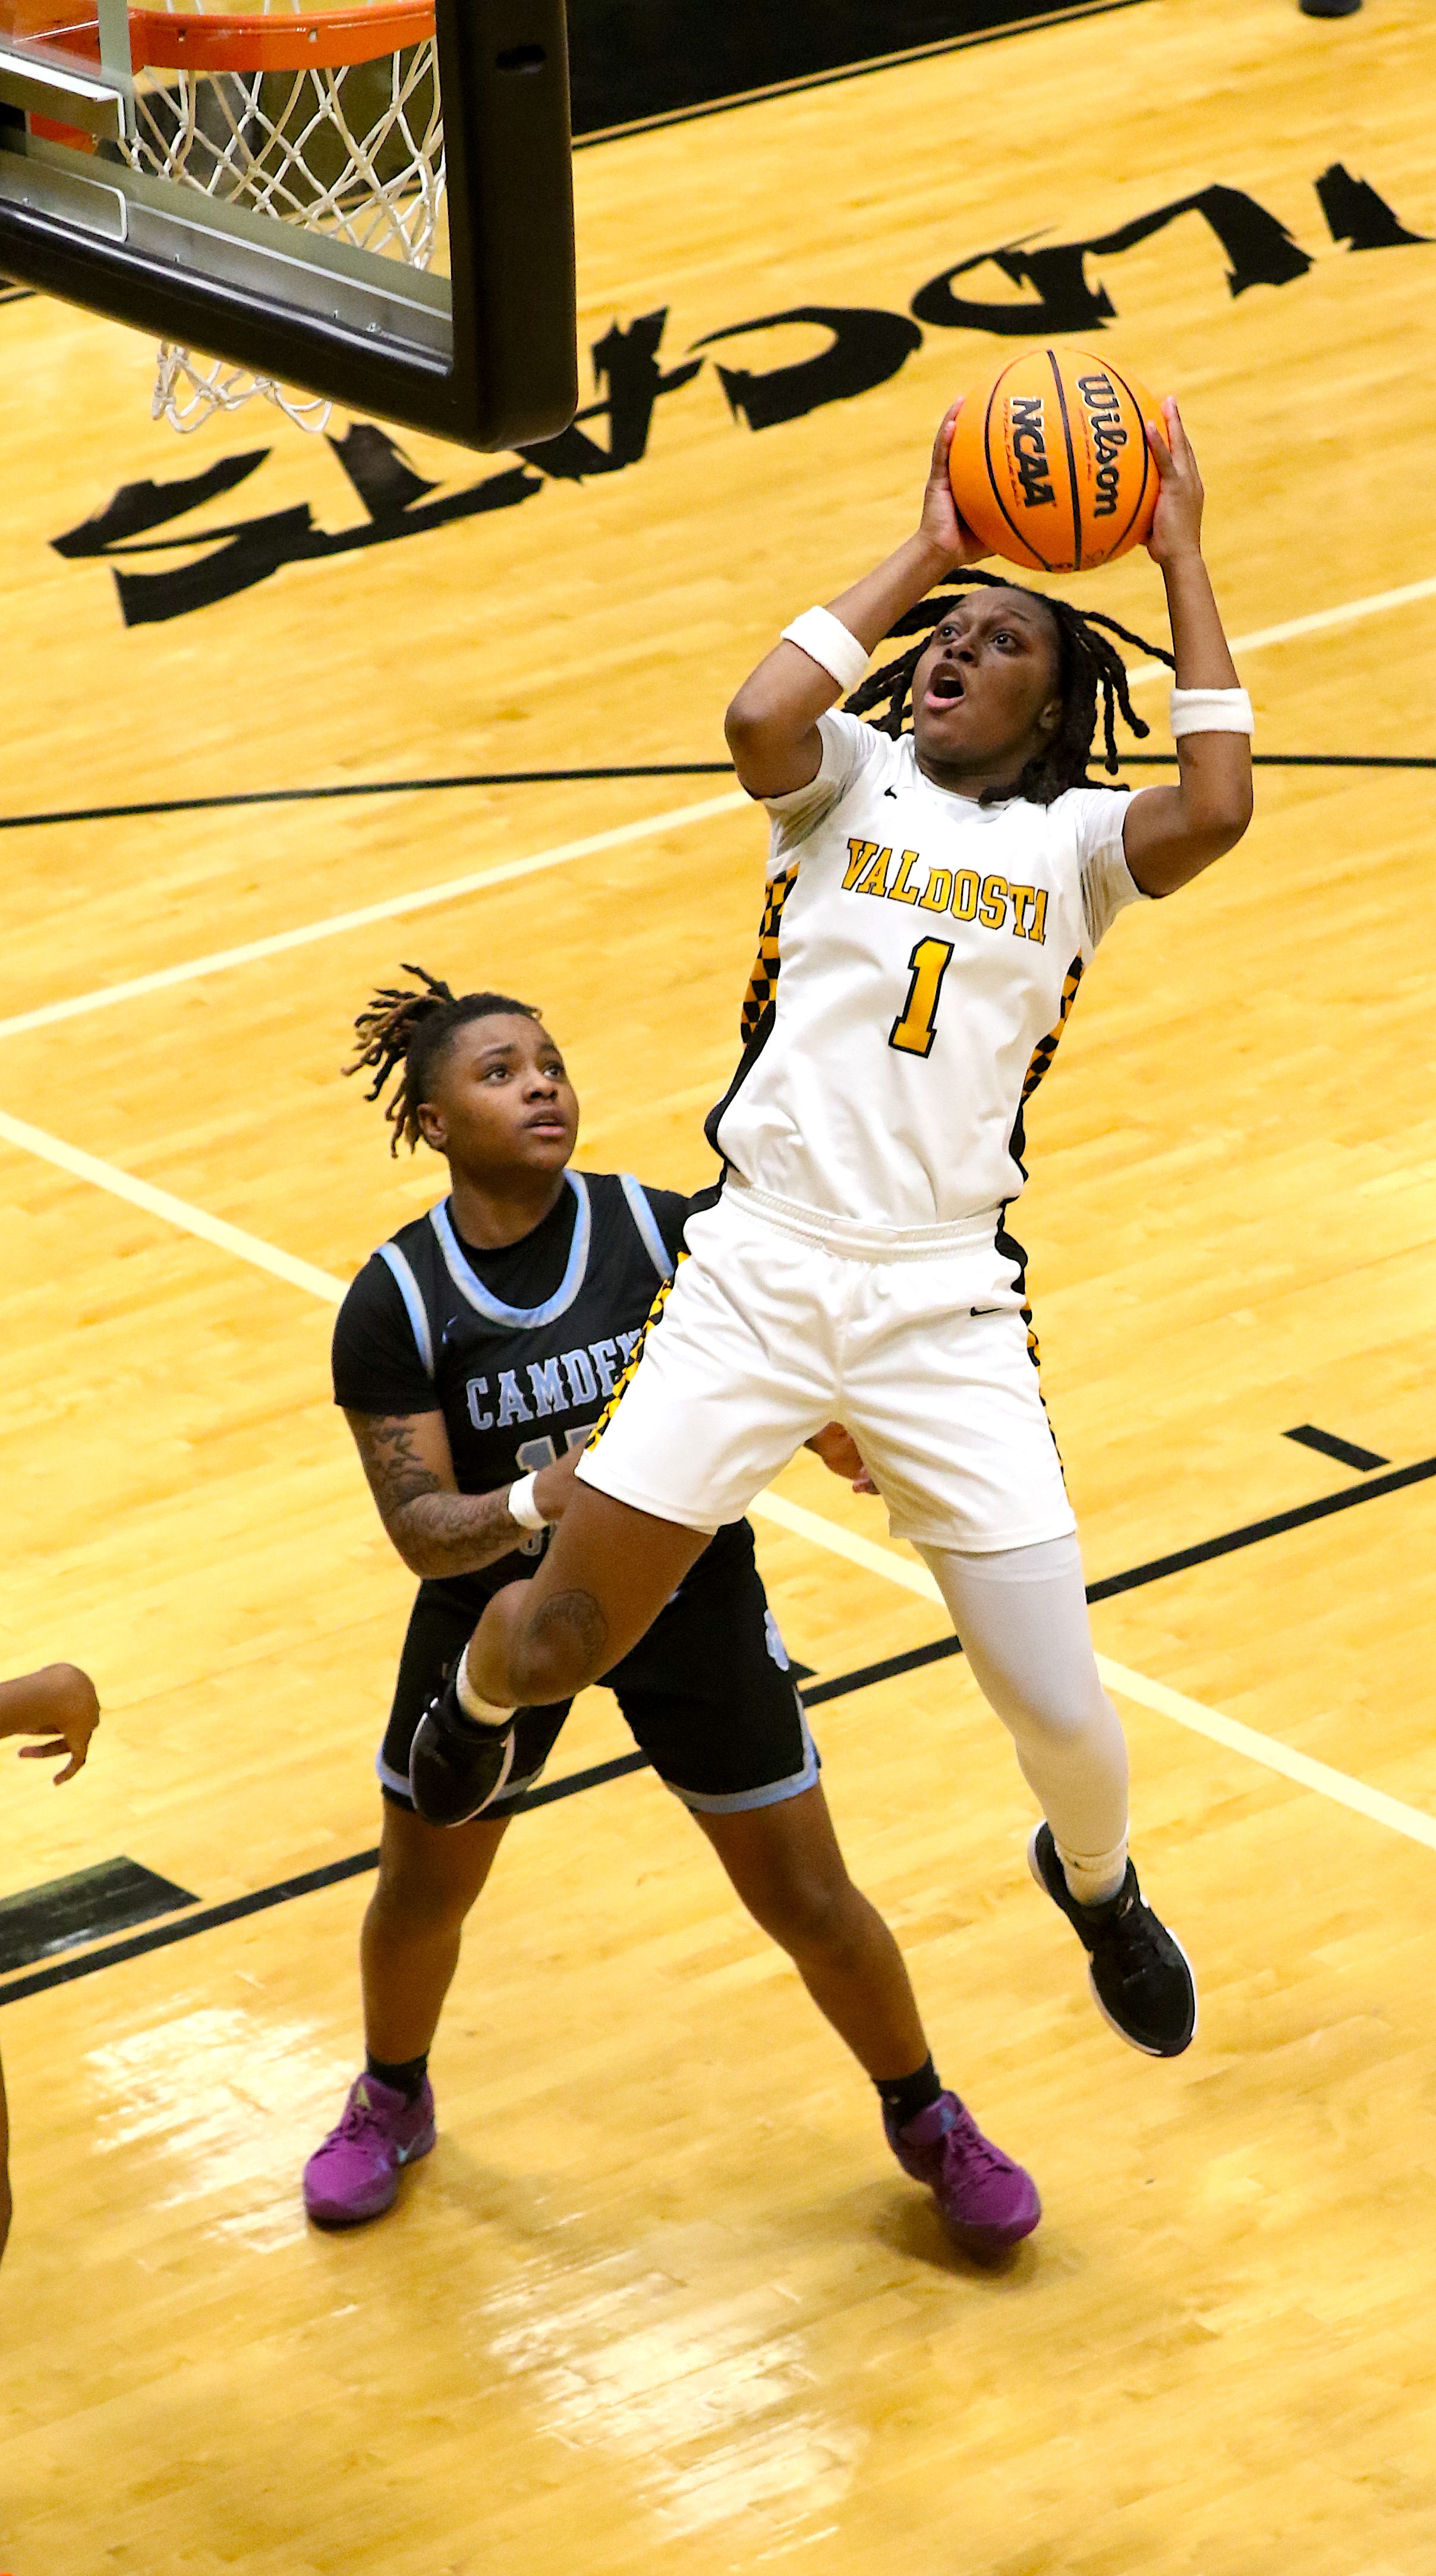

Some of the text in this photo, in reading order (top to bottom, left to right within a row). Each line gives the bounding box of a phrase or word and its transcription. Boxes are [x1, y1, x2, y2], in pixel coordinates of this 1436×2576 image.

[1009, 396, 1056, 508] NCAA
[1077, 372, 1128, 518] Wilson
[888, 936, 955, 1059] 1
